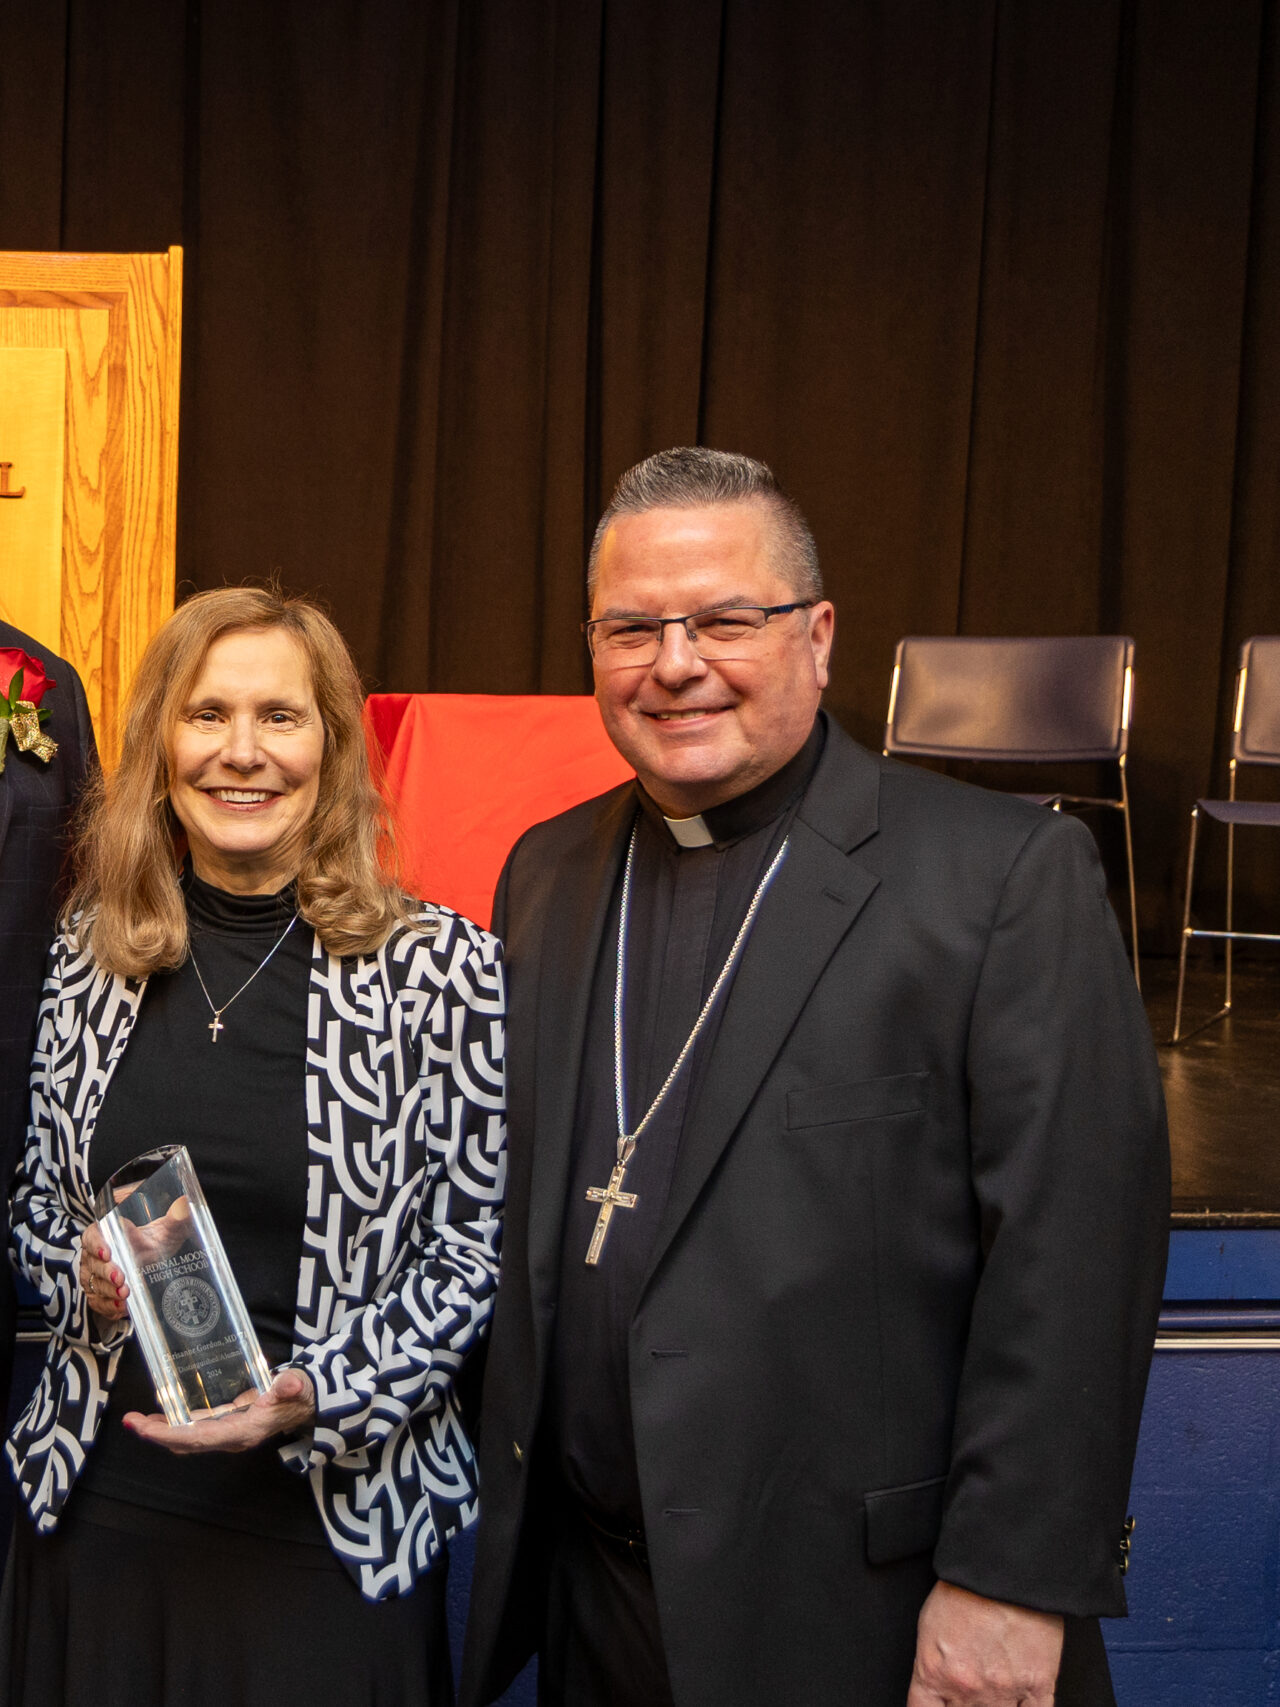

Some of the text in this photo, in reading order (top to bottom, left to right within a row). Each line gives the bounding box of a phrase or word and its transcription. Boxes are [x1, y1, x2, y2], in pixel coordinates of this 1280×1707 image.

[149, 1270, 173, 1284] HIGH
[223, 1334, 237, 1345] MD
[206, 1368, 223, 1379] 2024
